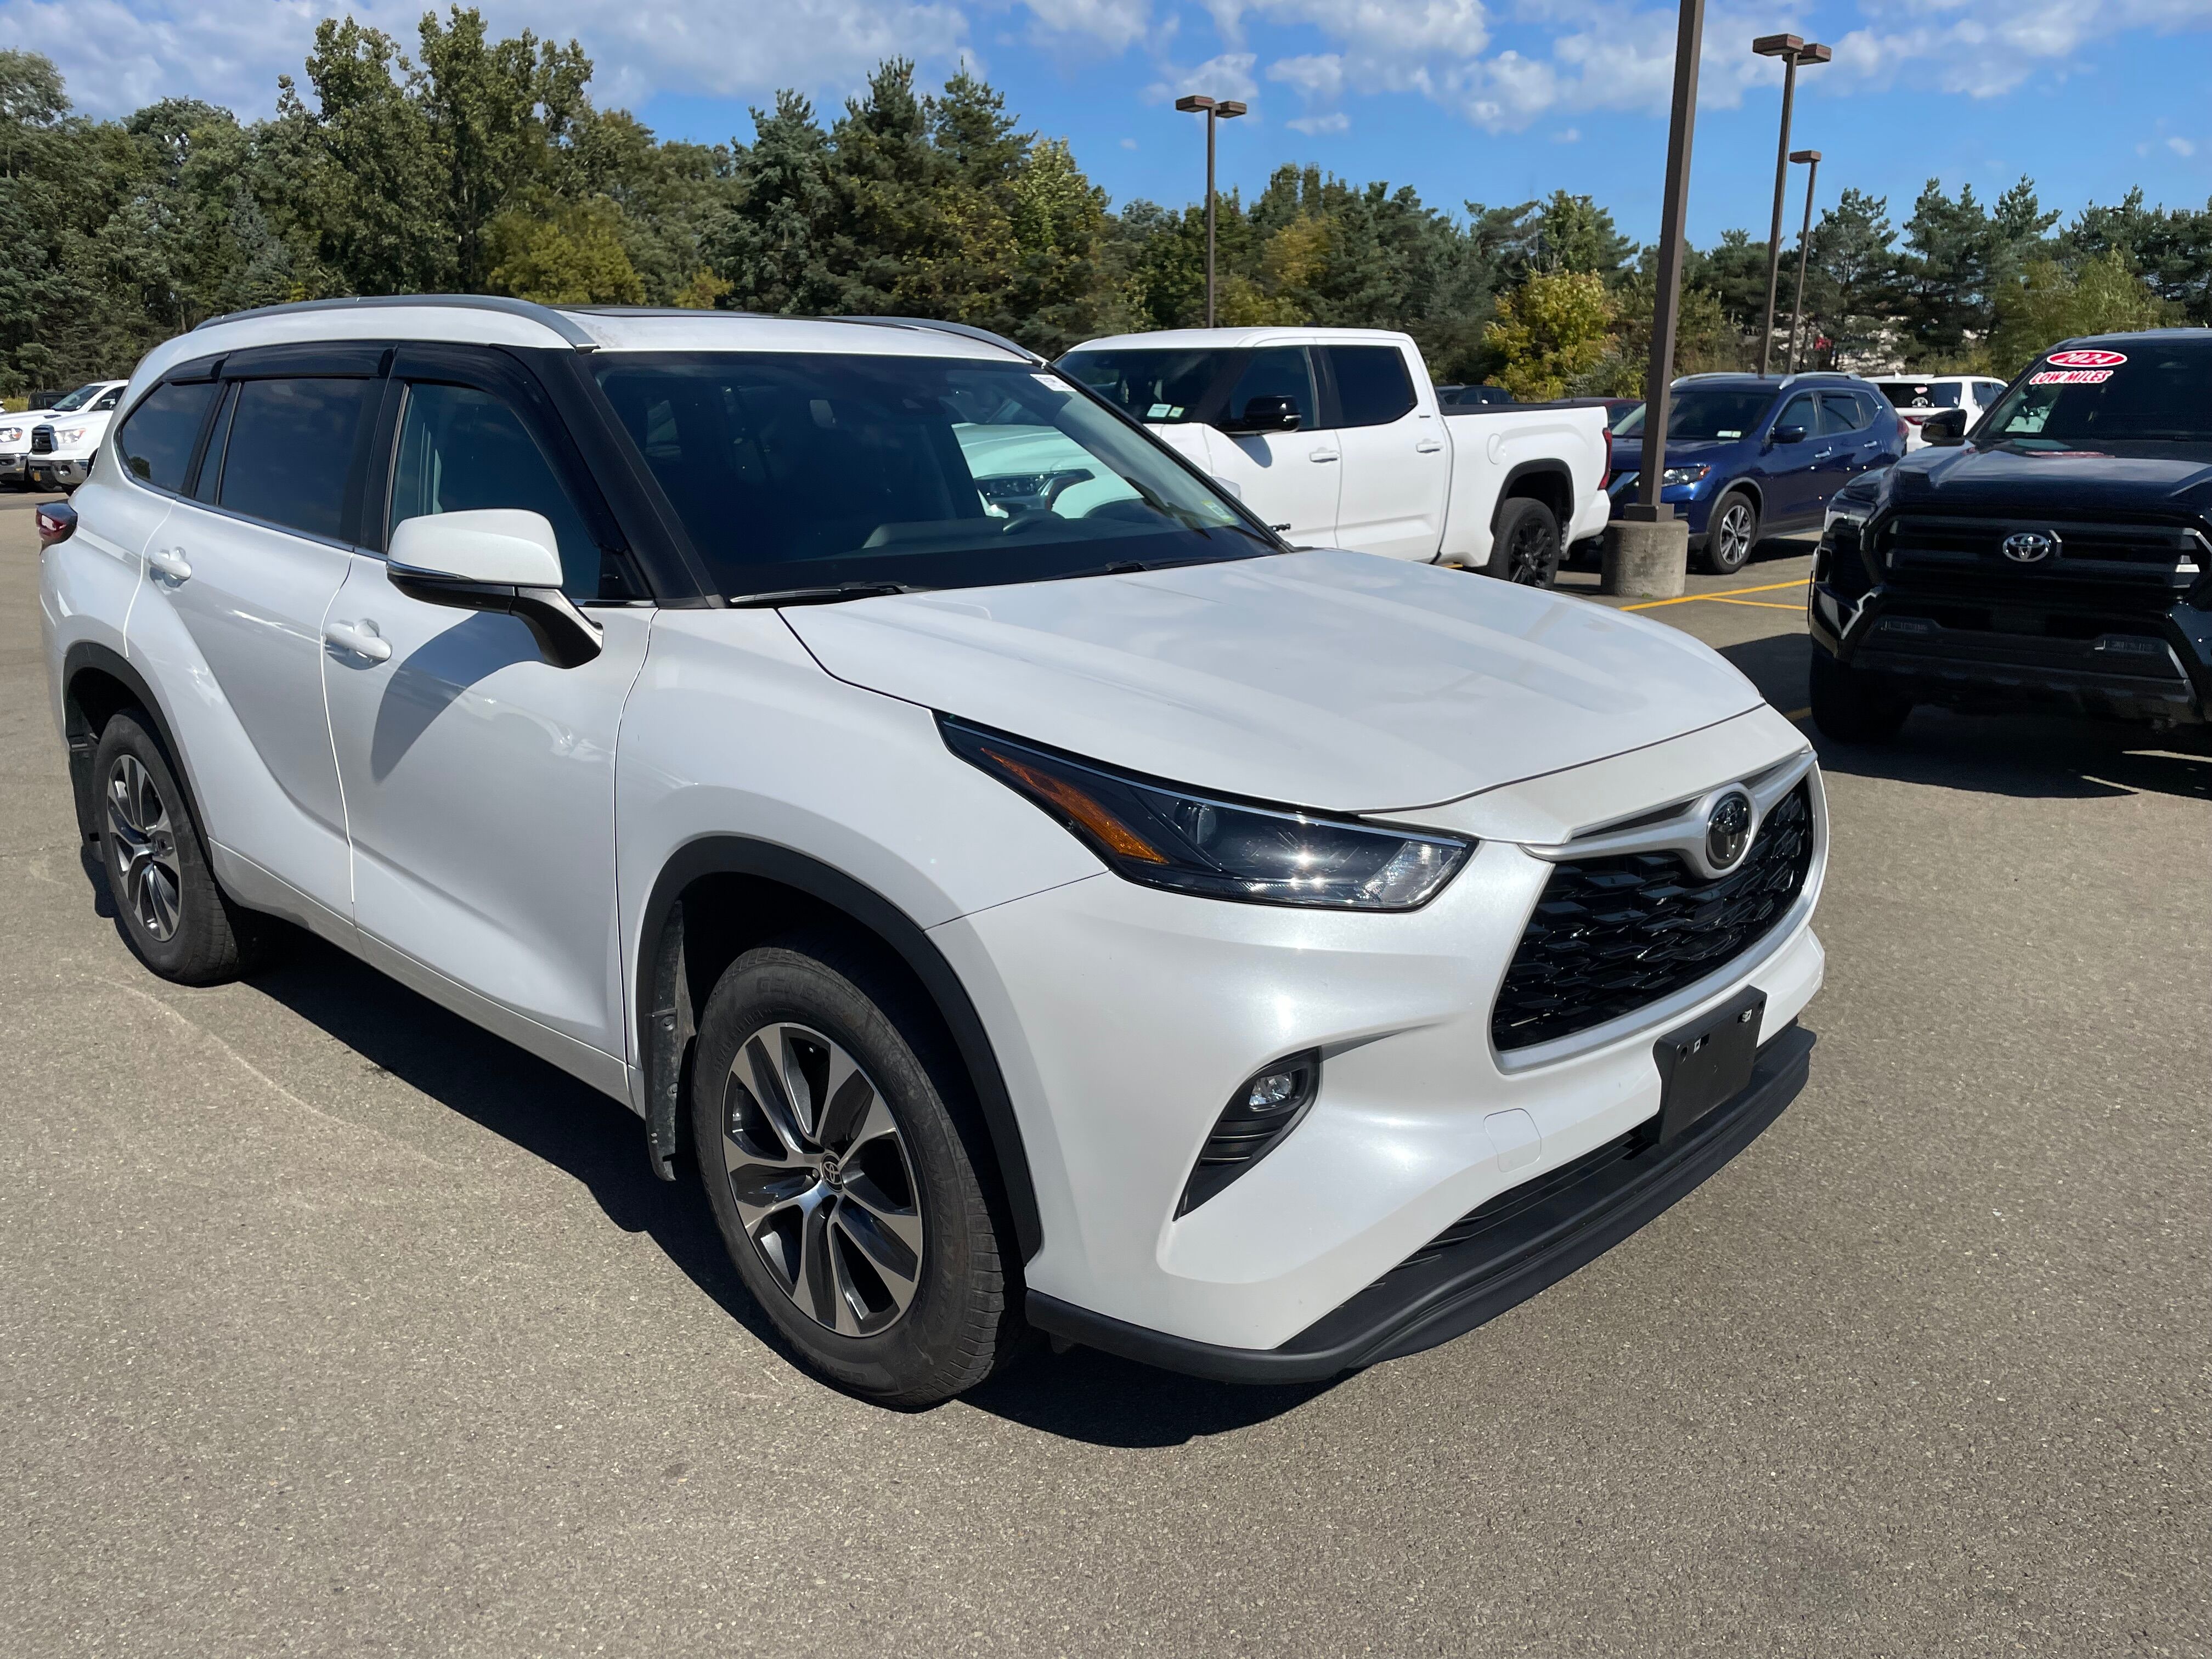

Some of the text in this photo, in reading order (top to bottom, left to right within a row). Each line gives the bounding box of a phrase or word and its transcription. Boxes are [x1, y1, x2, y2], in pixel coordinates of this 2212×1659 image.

[2053, 353, 2119, 364] 2024
[2031, 371, 2113, 383] LOW MILES
